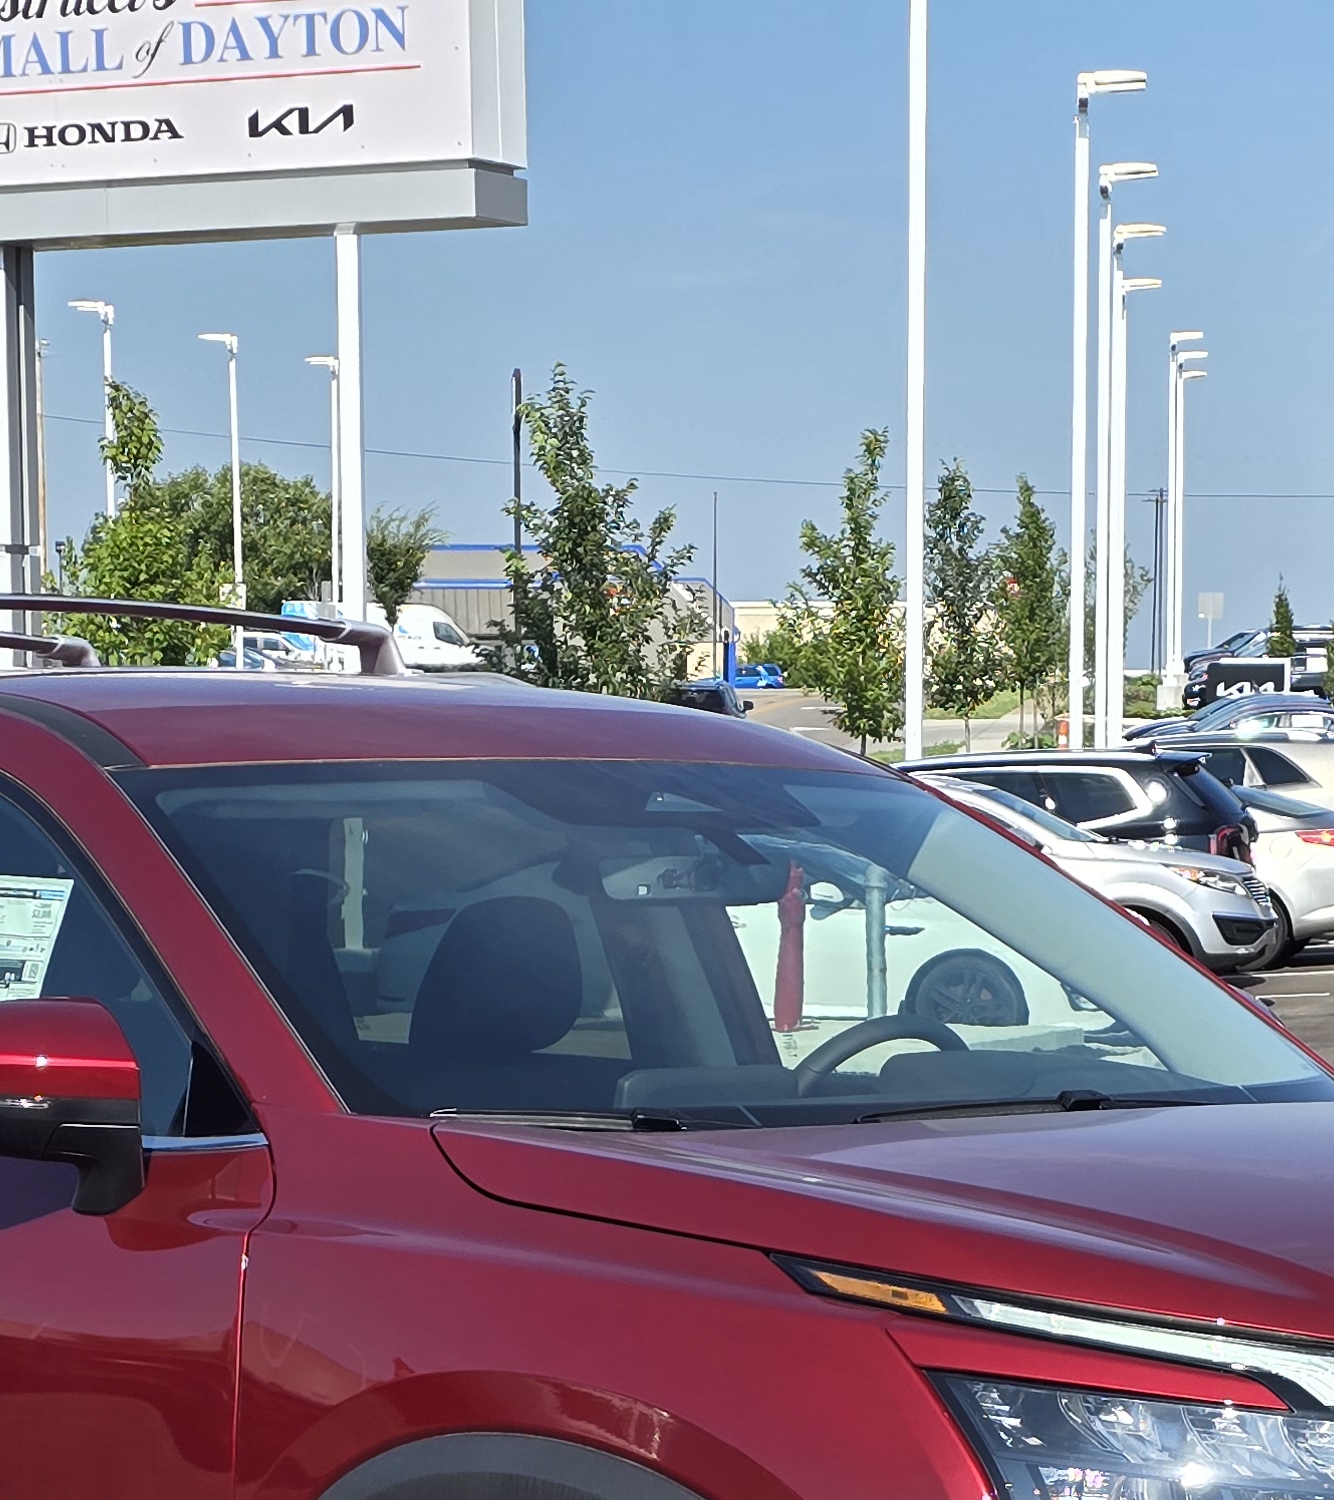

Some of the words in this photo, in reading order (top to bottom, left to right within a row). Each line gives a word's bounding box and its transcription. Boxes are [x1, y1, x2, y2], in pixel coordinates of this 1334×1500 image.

[132, 20, 174, 78] of
[178, 5, 409, 66] DAYTON
[23, 117, 185, 149] HONDA
[247, 103, 355, 139] KIA
